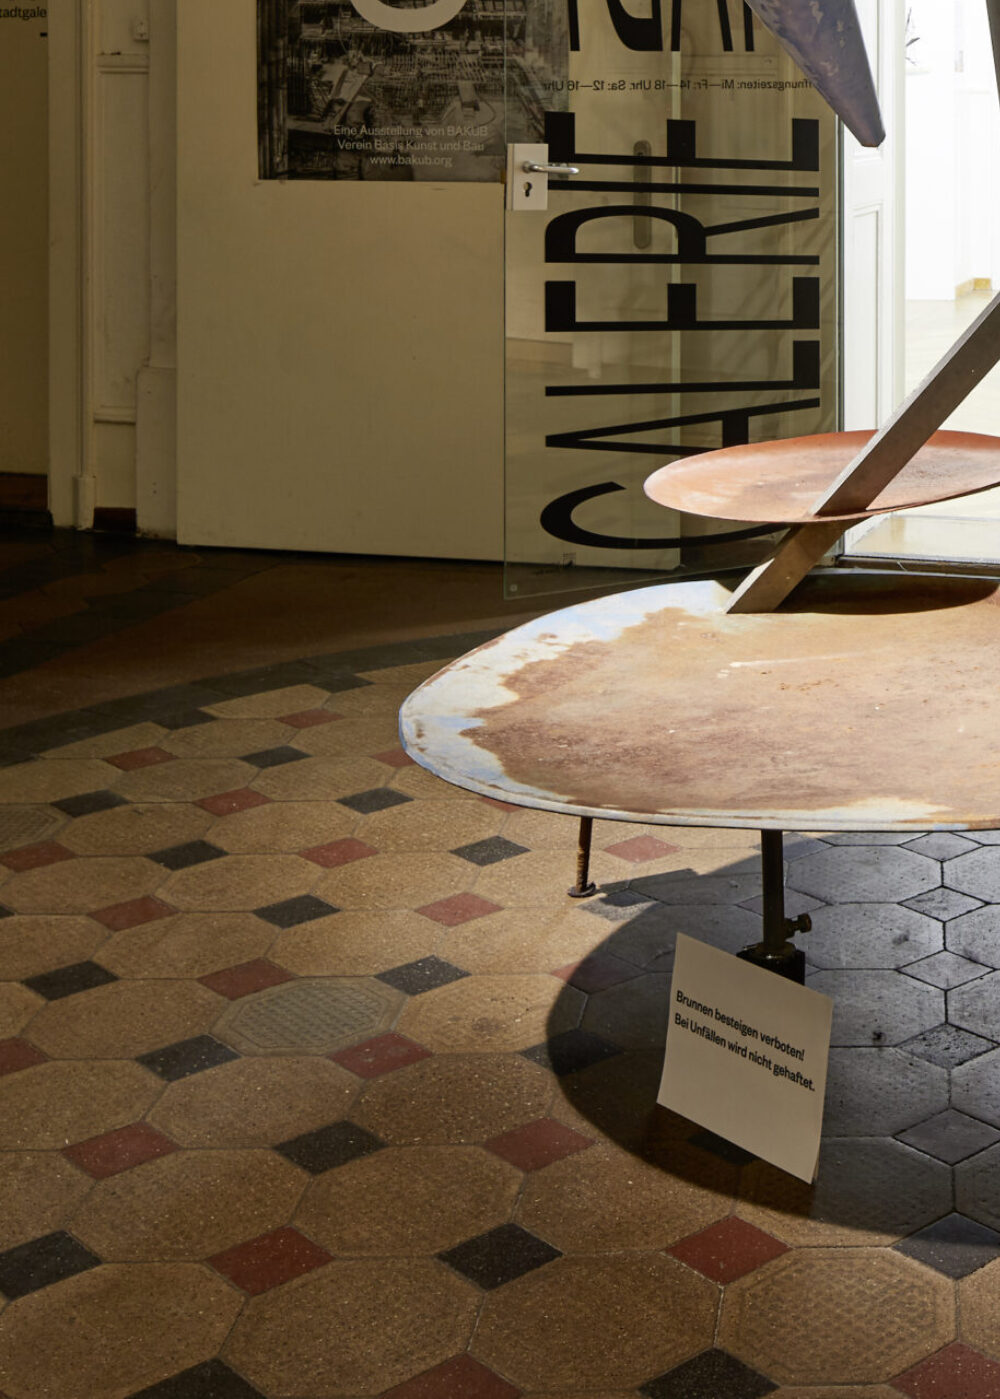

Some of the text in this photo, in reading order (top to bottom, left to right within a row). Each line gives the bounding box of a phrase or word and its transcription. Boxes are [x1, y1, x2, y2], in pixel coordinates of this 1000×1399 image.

[334, 124, 489, 137] Eine Ausstellung von BAKUB
[337, 138, 485, 152] Verein Basis Kunst und Bau
[369, 154, 453, 168] www.bakub.org
[676, 990, 806, 1062] Brunnen besteigen verboten!
[674, 1012, 816, 1092] Bei Unfällen wird nicht gehaftet.
